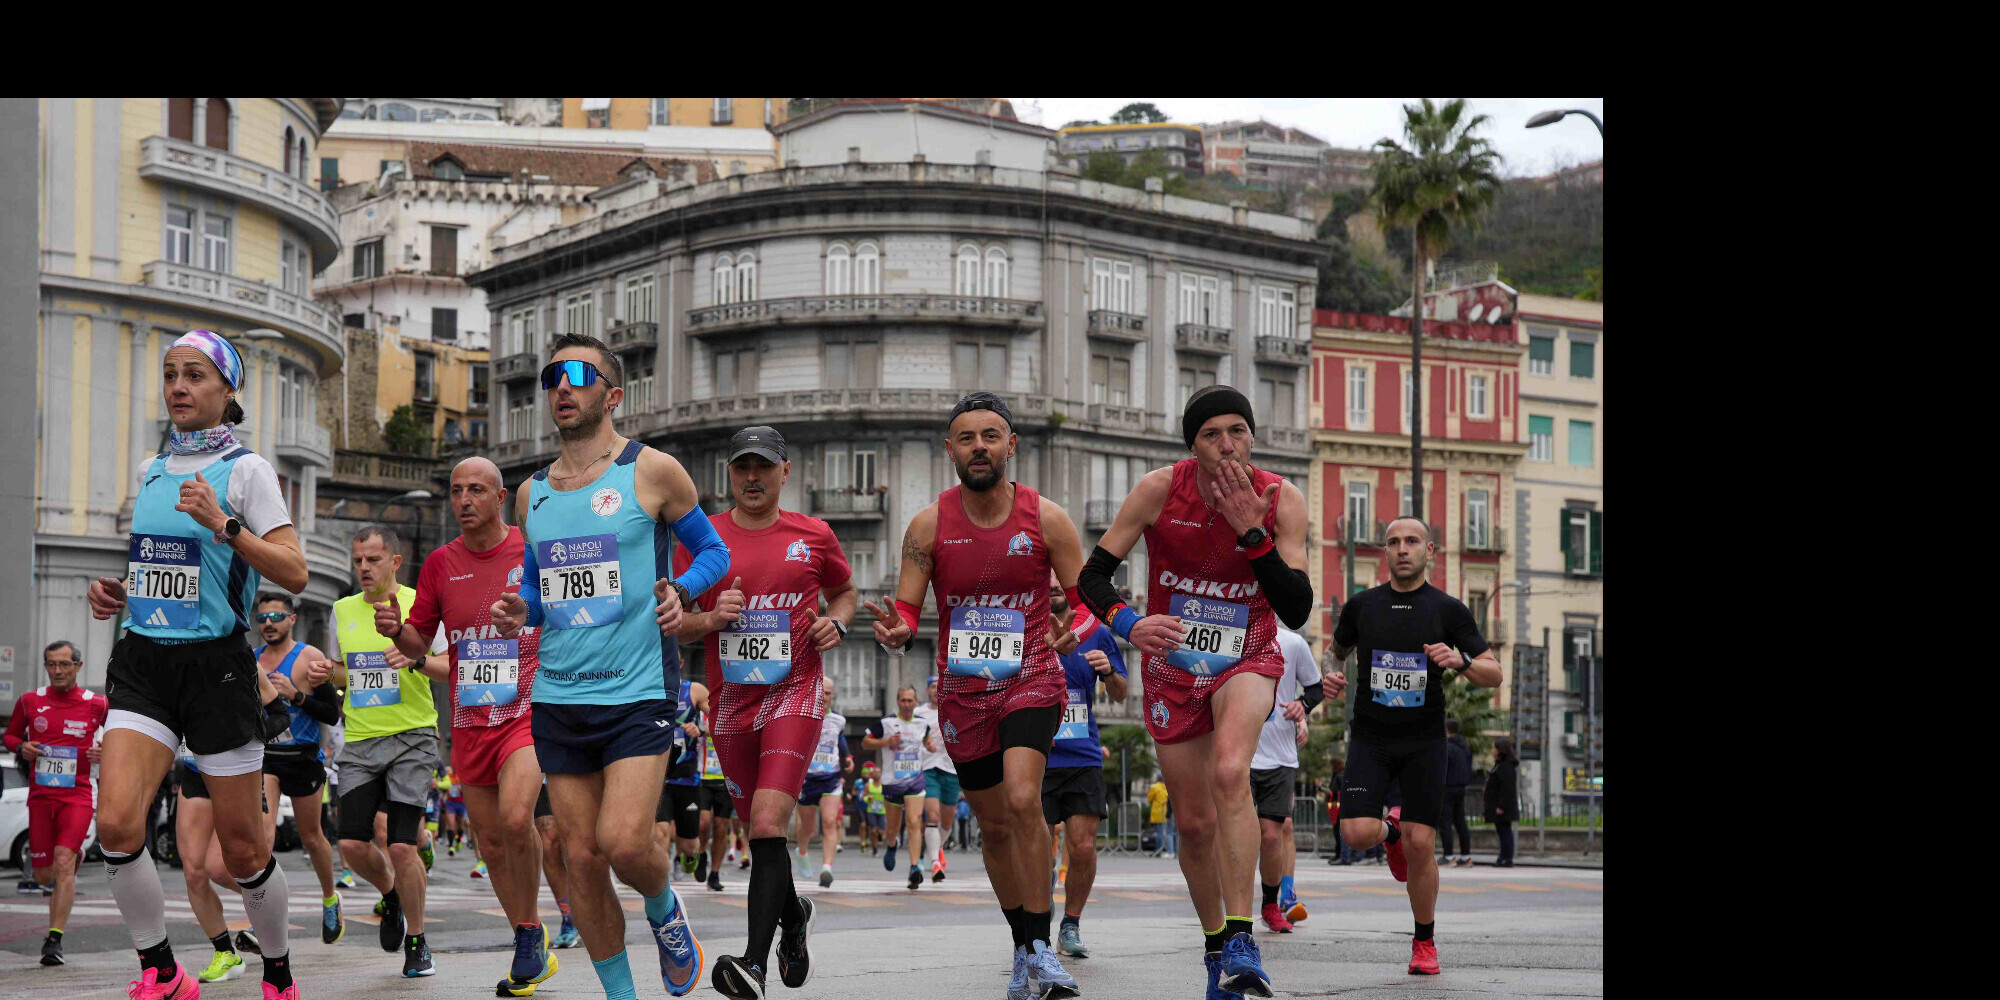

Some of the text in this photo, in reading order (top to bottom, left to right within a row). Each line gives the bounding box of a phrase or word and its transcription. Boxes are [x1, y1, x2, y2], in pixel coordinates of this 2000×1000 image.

[155, 541, 187, 552] NAPOLI
[568, 540, 603, 552] NAPOLI
[155, 551, 187, 561] RUNNING
[569, 551, 603, 561] RUNNING
[559, 570, 595, 600] 789
[1159, 570, 1259, 599] DAIKIN
[740, 592, 803, 611] IKIN
[946, 592, 1035, 609] DAIKIN
[983, 613, 1013, 622] NAPOLI
[1203, 603, 1237, 617] NAPOLI
[1203, 612, 1235, 623] RUNNING
[749, 614, 779, 622] NAPOLI
[983, 621, 1012, 629] RUNNING
[1185, 626, 1222, 654] 460
[737, 637, 770, 660] 462
[968, 636, 1003, 660] 949
[360, 671, 384, 690] 720
[473, 663, 499, 684] 461
[577, 668, 626, 681] RUNNING
[1384, 672, 1411, 691] 945
[1063, 707, 1076, 723] 91
[46, 760, 63, 774] 716
